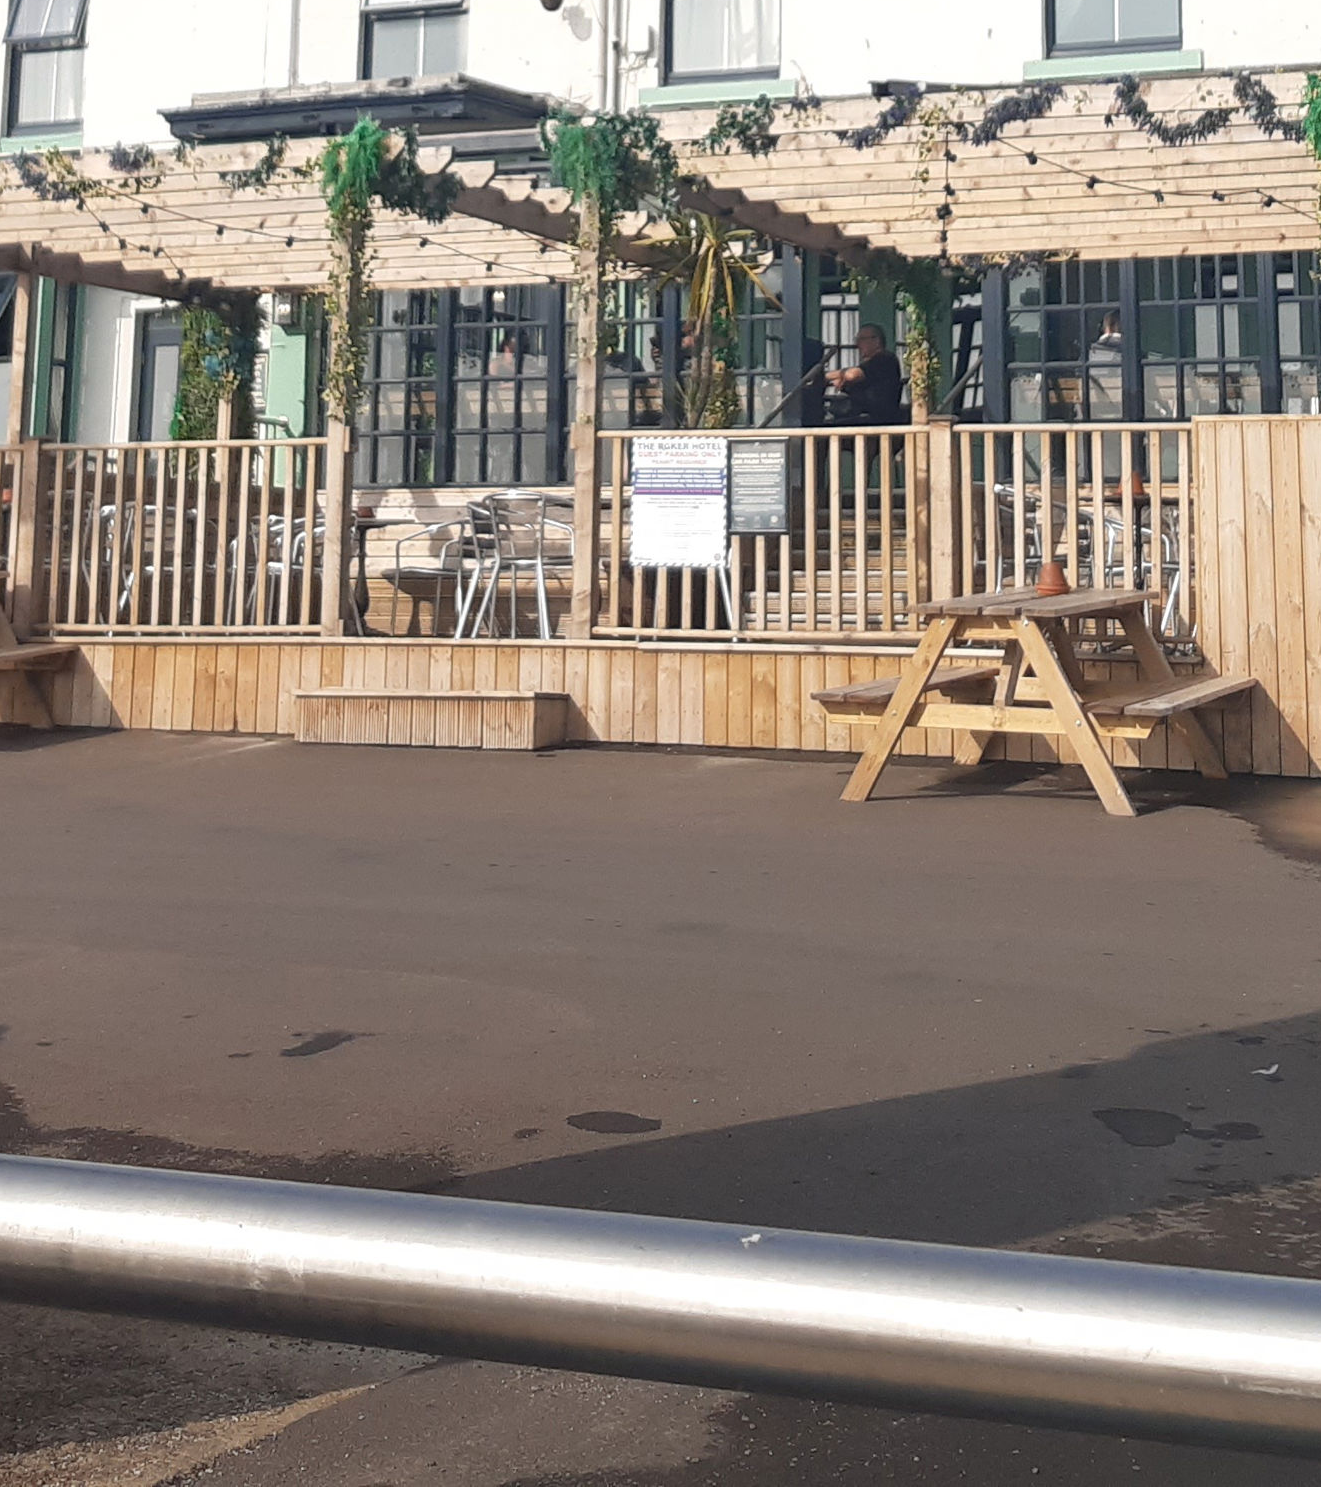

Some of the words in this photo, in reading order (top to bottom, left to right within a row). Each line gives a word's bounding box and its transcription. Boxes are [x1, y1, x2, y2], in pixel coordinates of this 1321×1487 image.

[637, 442, 655, 450] THE
[658, 442, 689, 451] ROKER
[692, 442, 722, 451] HOTEL
